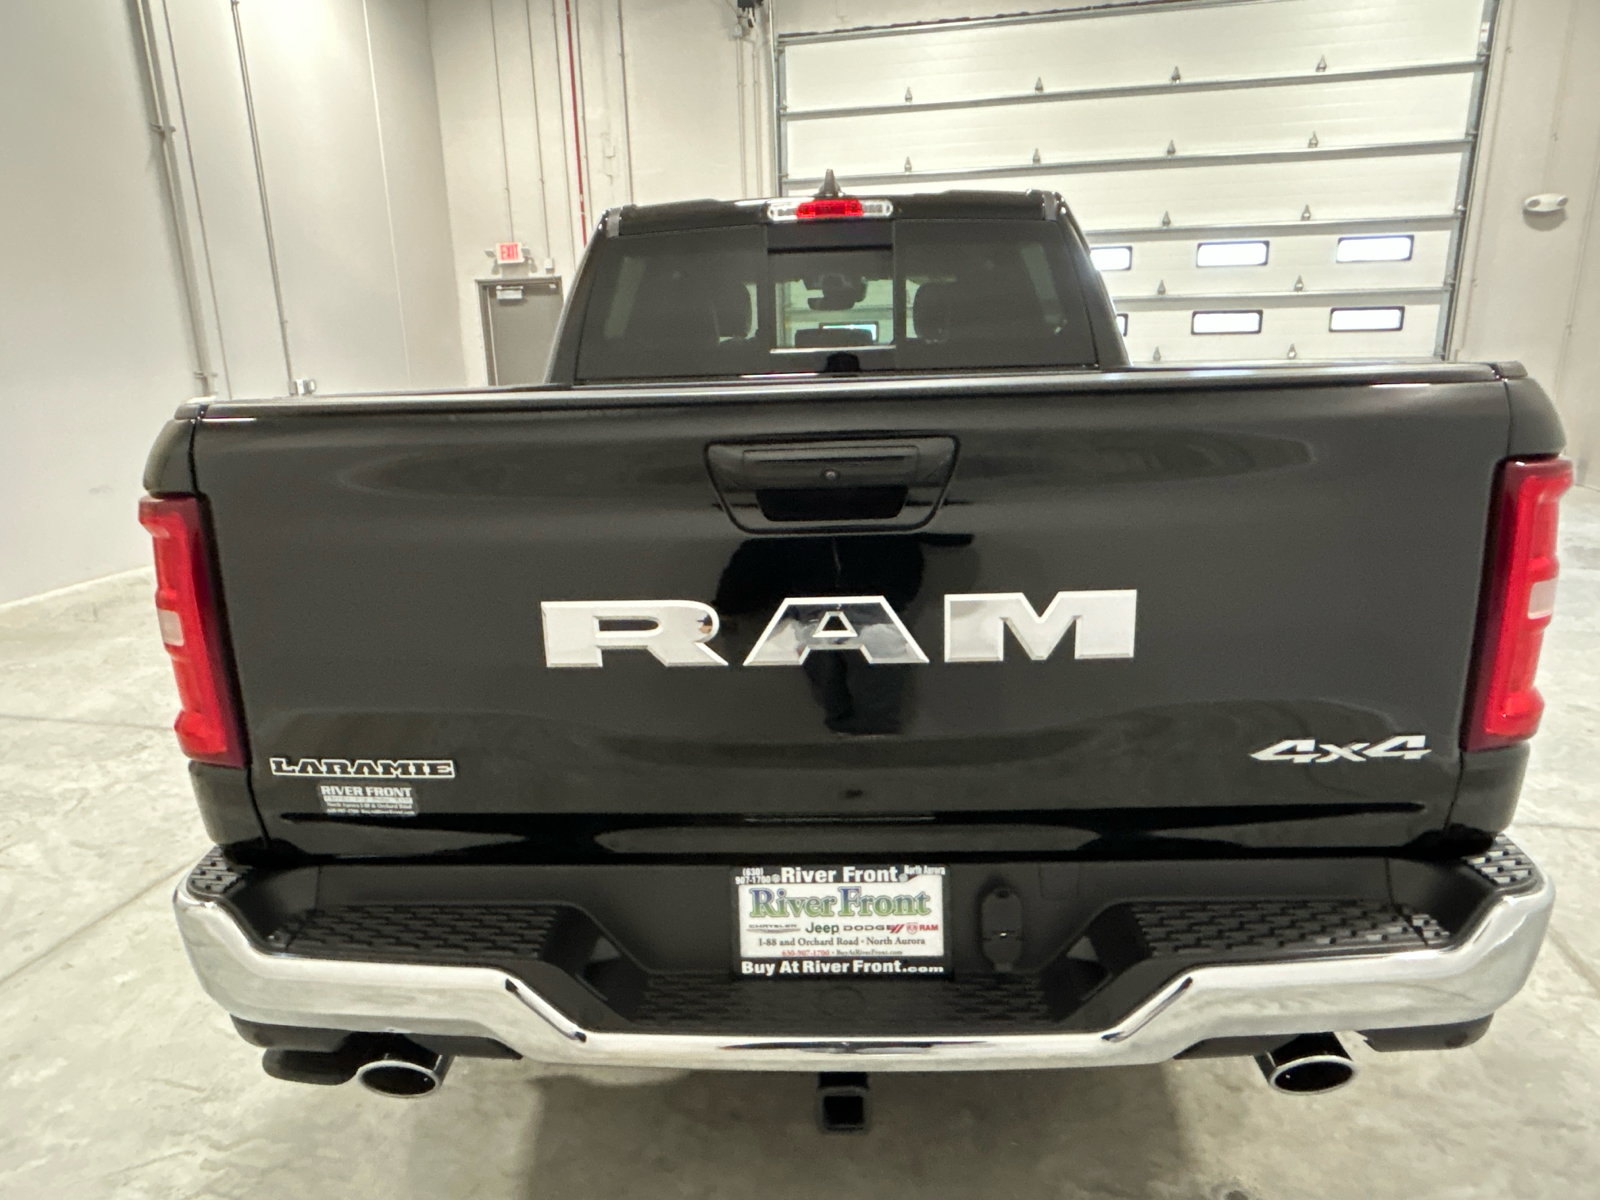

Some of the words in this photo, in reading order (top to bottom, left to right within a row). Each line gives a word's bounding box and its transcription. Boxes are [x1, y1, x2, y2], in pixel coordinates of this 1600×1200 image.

[500, 243, 519, 261] EXIT
[541, 589, 1138, 668] RAM
[1250, 735, 1432, 763] 4x4
[269, 757, 456, 778] LARAMIE
[320, 785, 363, 796] RIVER
[364, 786, 412, 797] FRONT
[742, 867, 764, 876] (630)
[781, 866, 837, 883] River
[843, 866, 898, 883] Front
[735, 875, 771, 885] 907-1700
[805, 922, 840, 935] Jeep
[843, 924, 894, 932] DODGE
[779, 937, 796, 946] and
[797, 937, 834, 946] Orchard
[836, 936, 859, 946] Road
[866, 936, 893, 945] North
[894, 936, 926, 945] Aurora
[741, 961, 776, 976] Buy
[779, 960, 800, 973] At
[802, 960, 850, 973] River
[852, 959, 944, 973] Front.com
